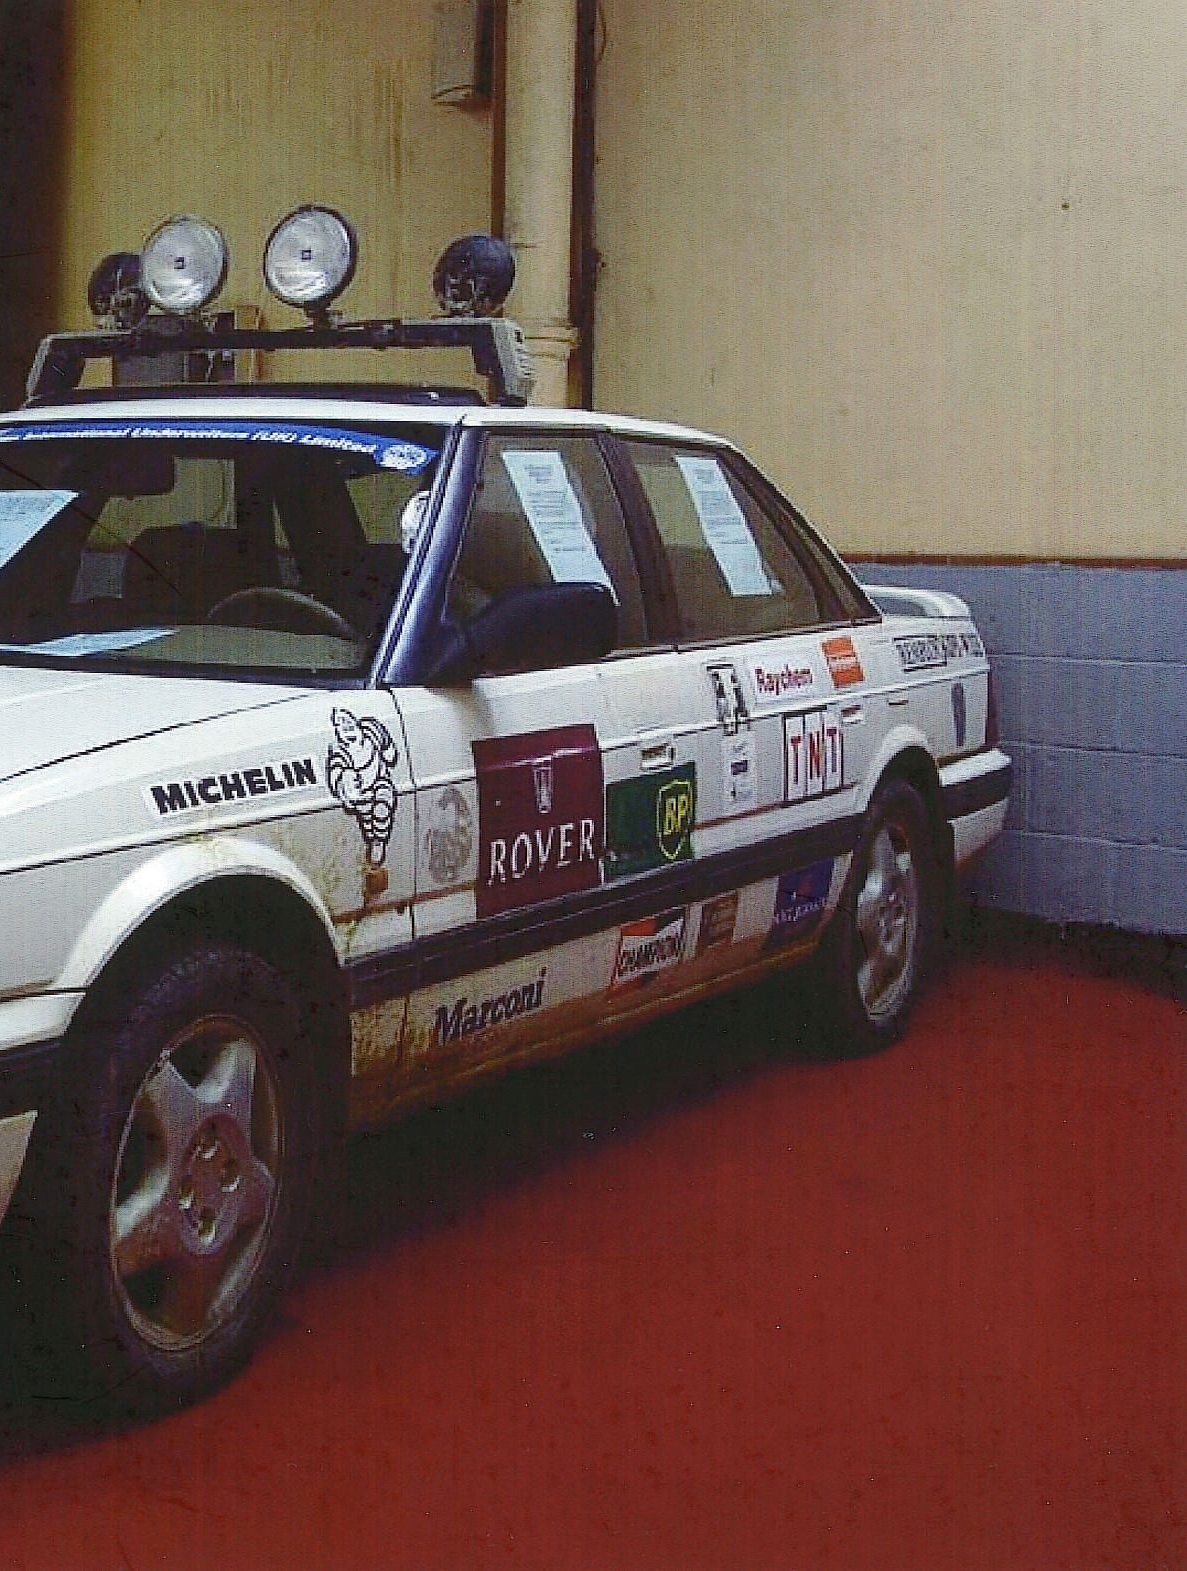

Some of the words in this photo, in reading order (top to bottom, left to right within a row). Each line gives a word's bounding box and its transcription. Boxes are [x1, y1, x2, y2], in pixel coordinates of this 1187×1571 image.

[299, 434, 378, 454] Limited
[755, 663, 813, 695] Raychem
[789, 726, 838, 785] TNT
[150, 759, 317, 815] MICHELIN
[664, 793, 690, 837] BP
[487, 818, 596, 887] ROVER
[433, 966, 548, 1047] Marconi
